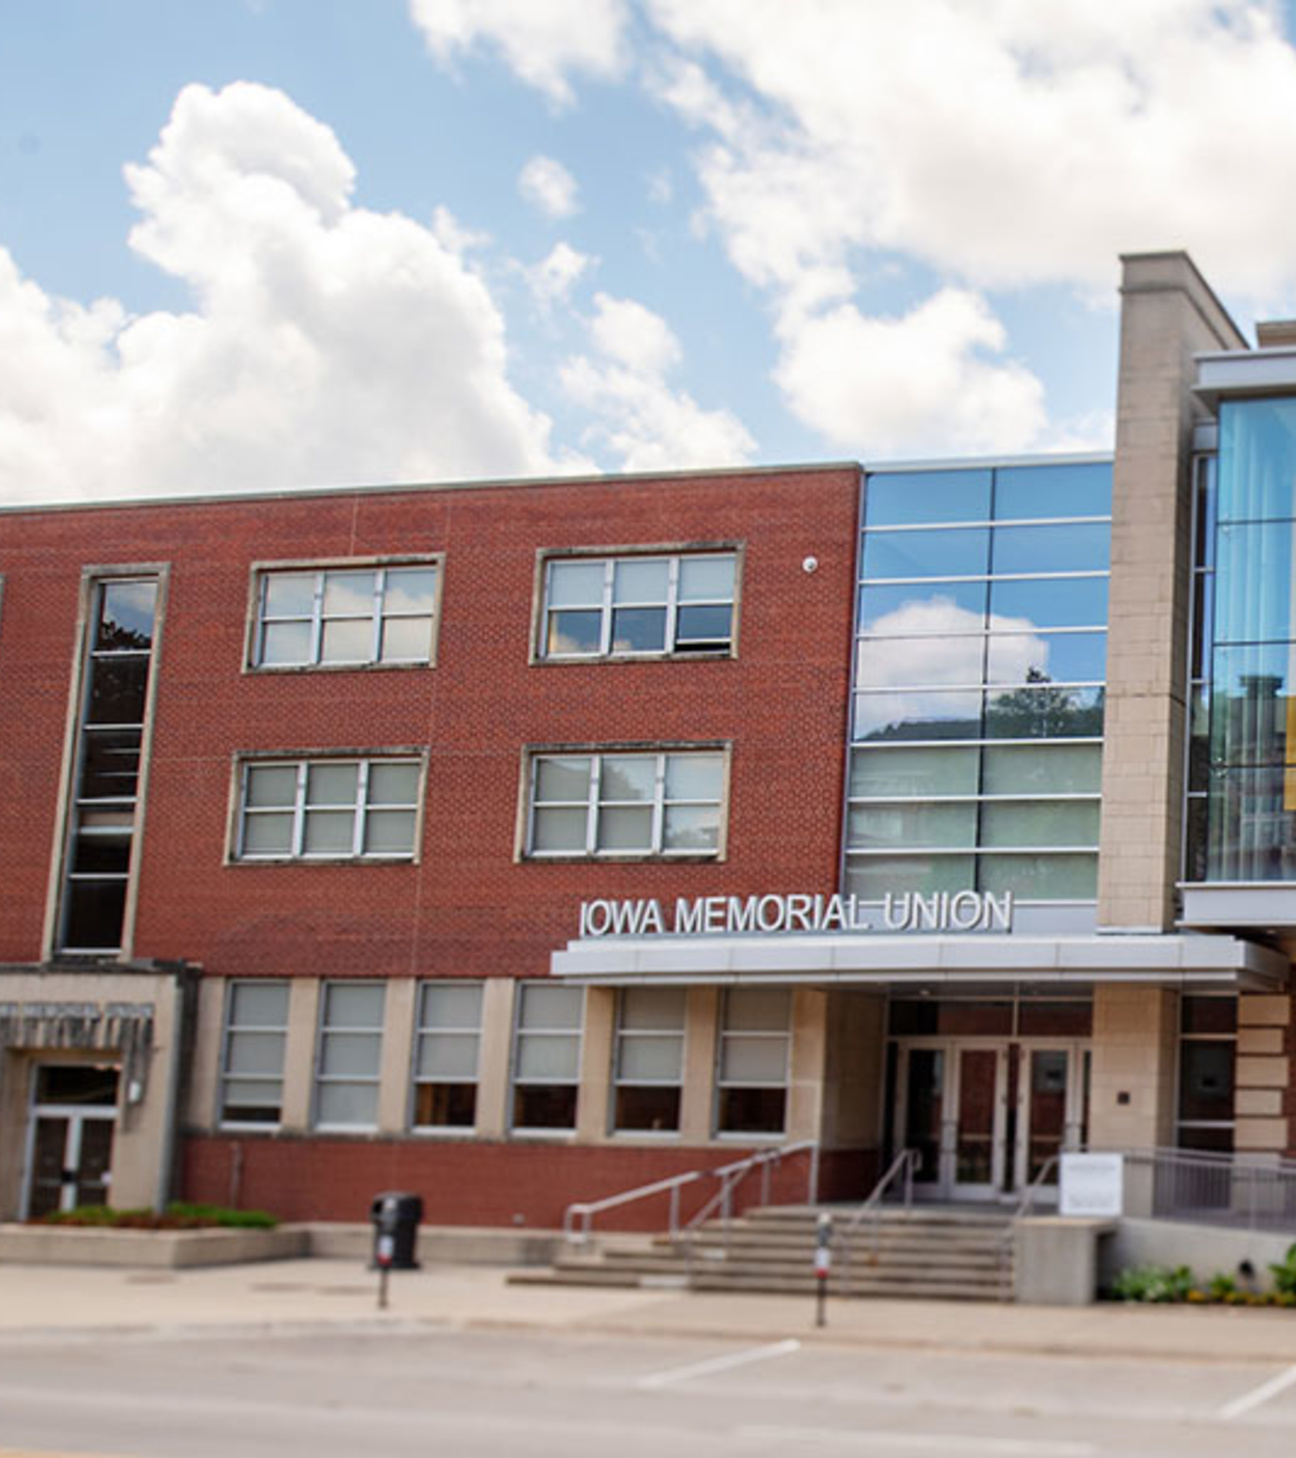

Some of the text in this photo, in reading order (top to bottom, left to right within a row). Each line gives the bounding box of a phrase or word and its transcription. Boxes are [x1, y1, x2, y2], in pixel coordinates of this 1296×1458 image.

[579, 890, 1012, 936] IOWA MEMORIAL UNION
